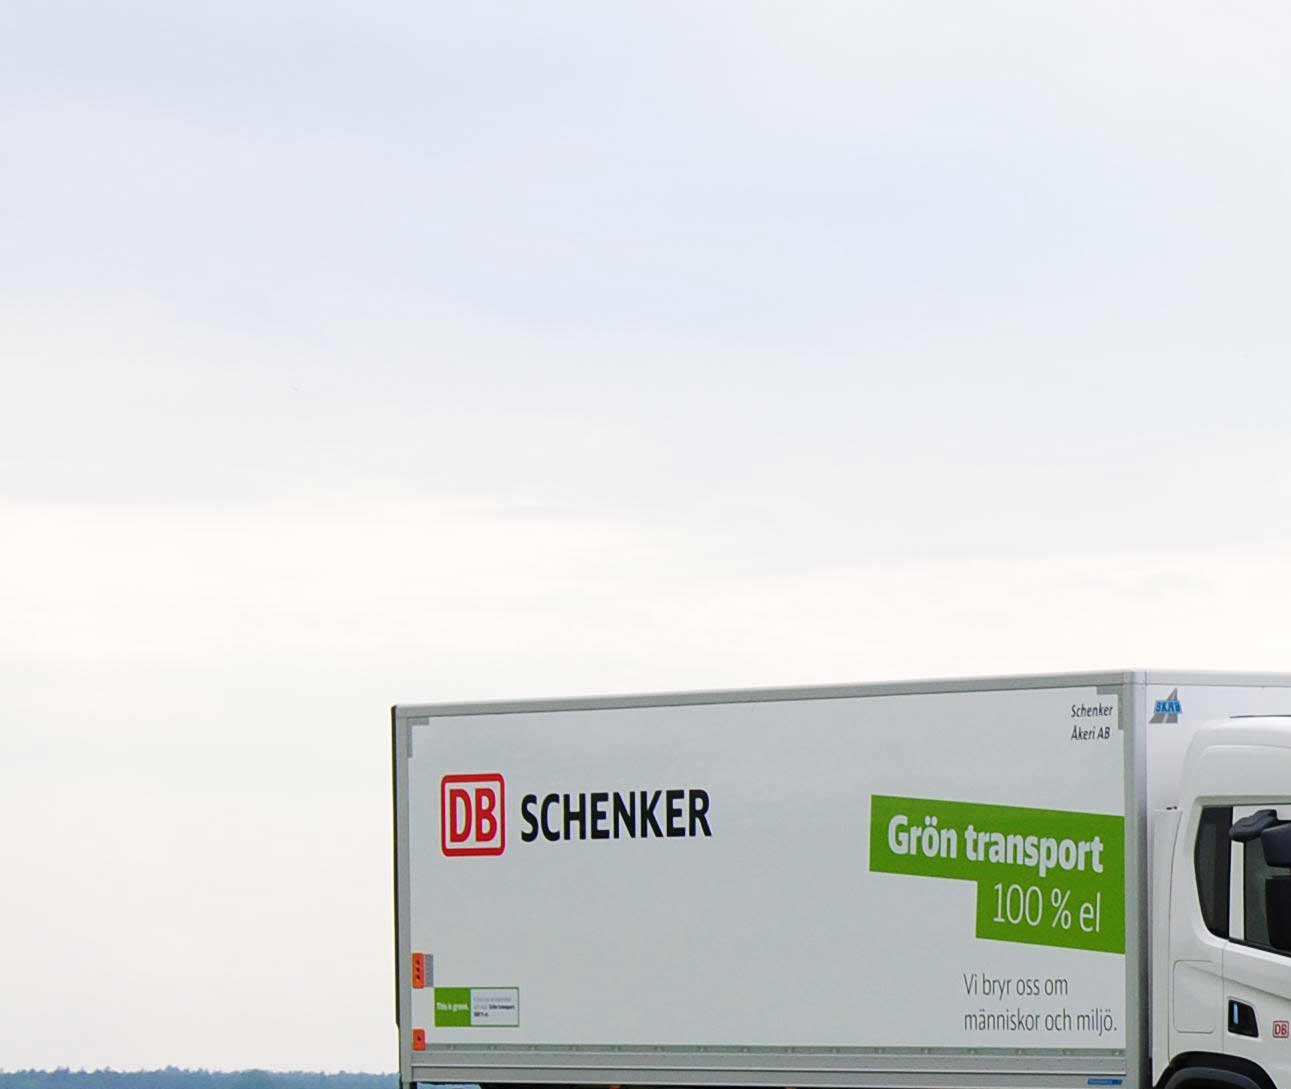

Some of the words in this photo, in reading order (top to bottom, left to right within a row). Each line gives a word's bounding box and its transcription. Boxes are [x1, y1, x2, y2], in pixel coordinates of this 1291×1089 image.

[1071, 702, 1113, 718] Schenker
[1070, 725, 1096, 740] Åkeri
[1096, 726, 1111, 740] AB
[449, 787, 498, 843] DB
[521, 789, 713, 842] SCHENKER
[888, 814, 958, 859] Grön
[965, 824, 1104, 878] transport
[993, 883, 1043, 926] 100
[1051, 888, 1072, 930] %
[1079, 892, 1101, 933] el
[963, 973, 979, 996] Vi
[982, 973, 1012, 1000] bryr
[1016, 977, 1040, 996] oss
[1044, 977, 1069, 996] om
[964, 1008, 1040, 1031] människor
[1045, 1008, 1071, 1032] och
[1077, 1008, 1118, 1036] miljö.
